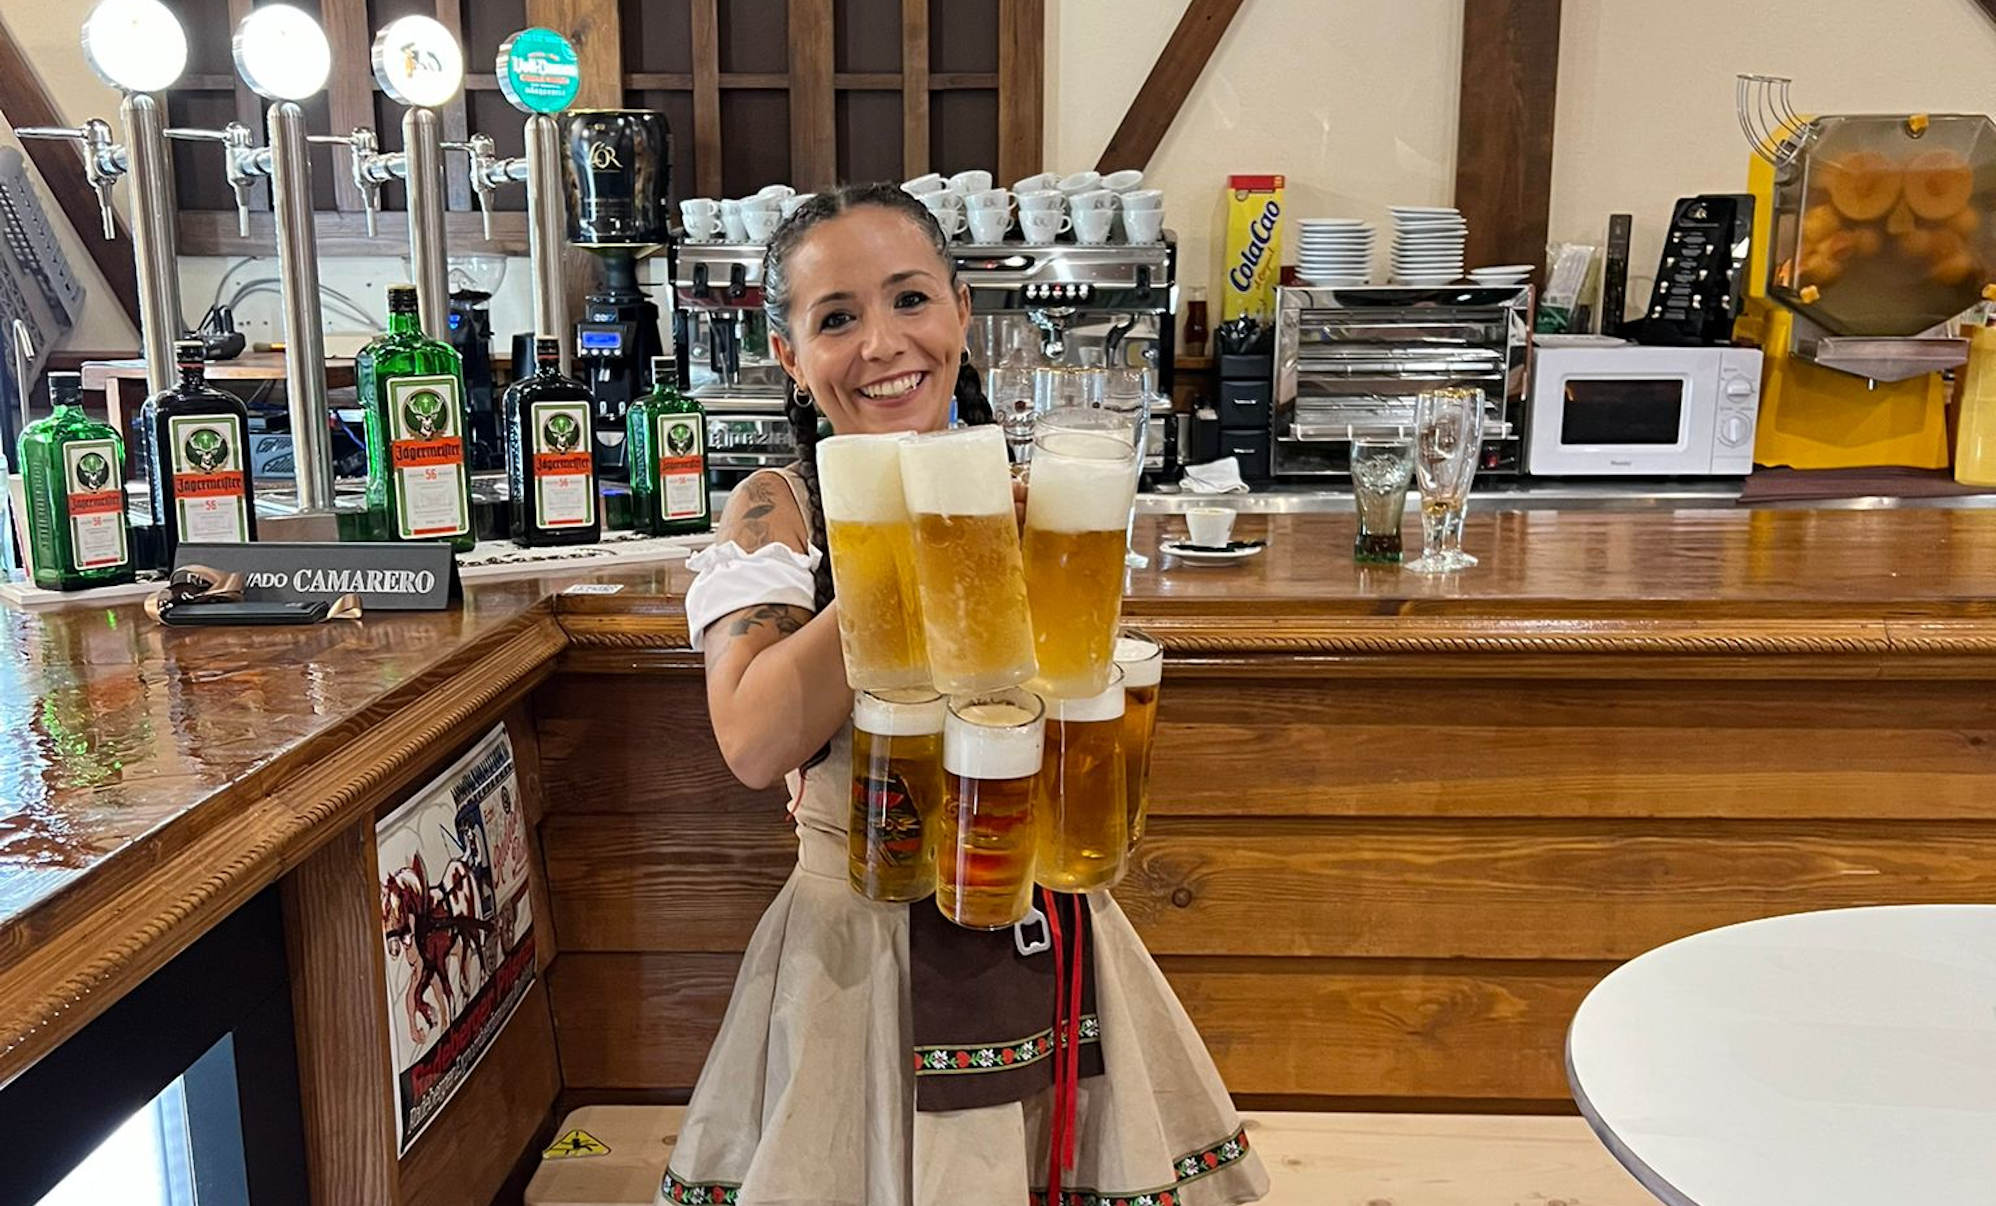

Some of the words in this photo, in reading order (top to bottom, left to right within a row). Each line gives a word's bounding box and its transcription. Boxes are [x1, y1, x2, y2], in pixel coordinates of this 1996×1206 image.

[1229, 200, 1280, 292] ColaCao
[425, 469, 437, 480] 56
[292, 569, 435, 594] CAMARERO
